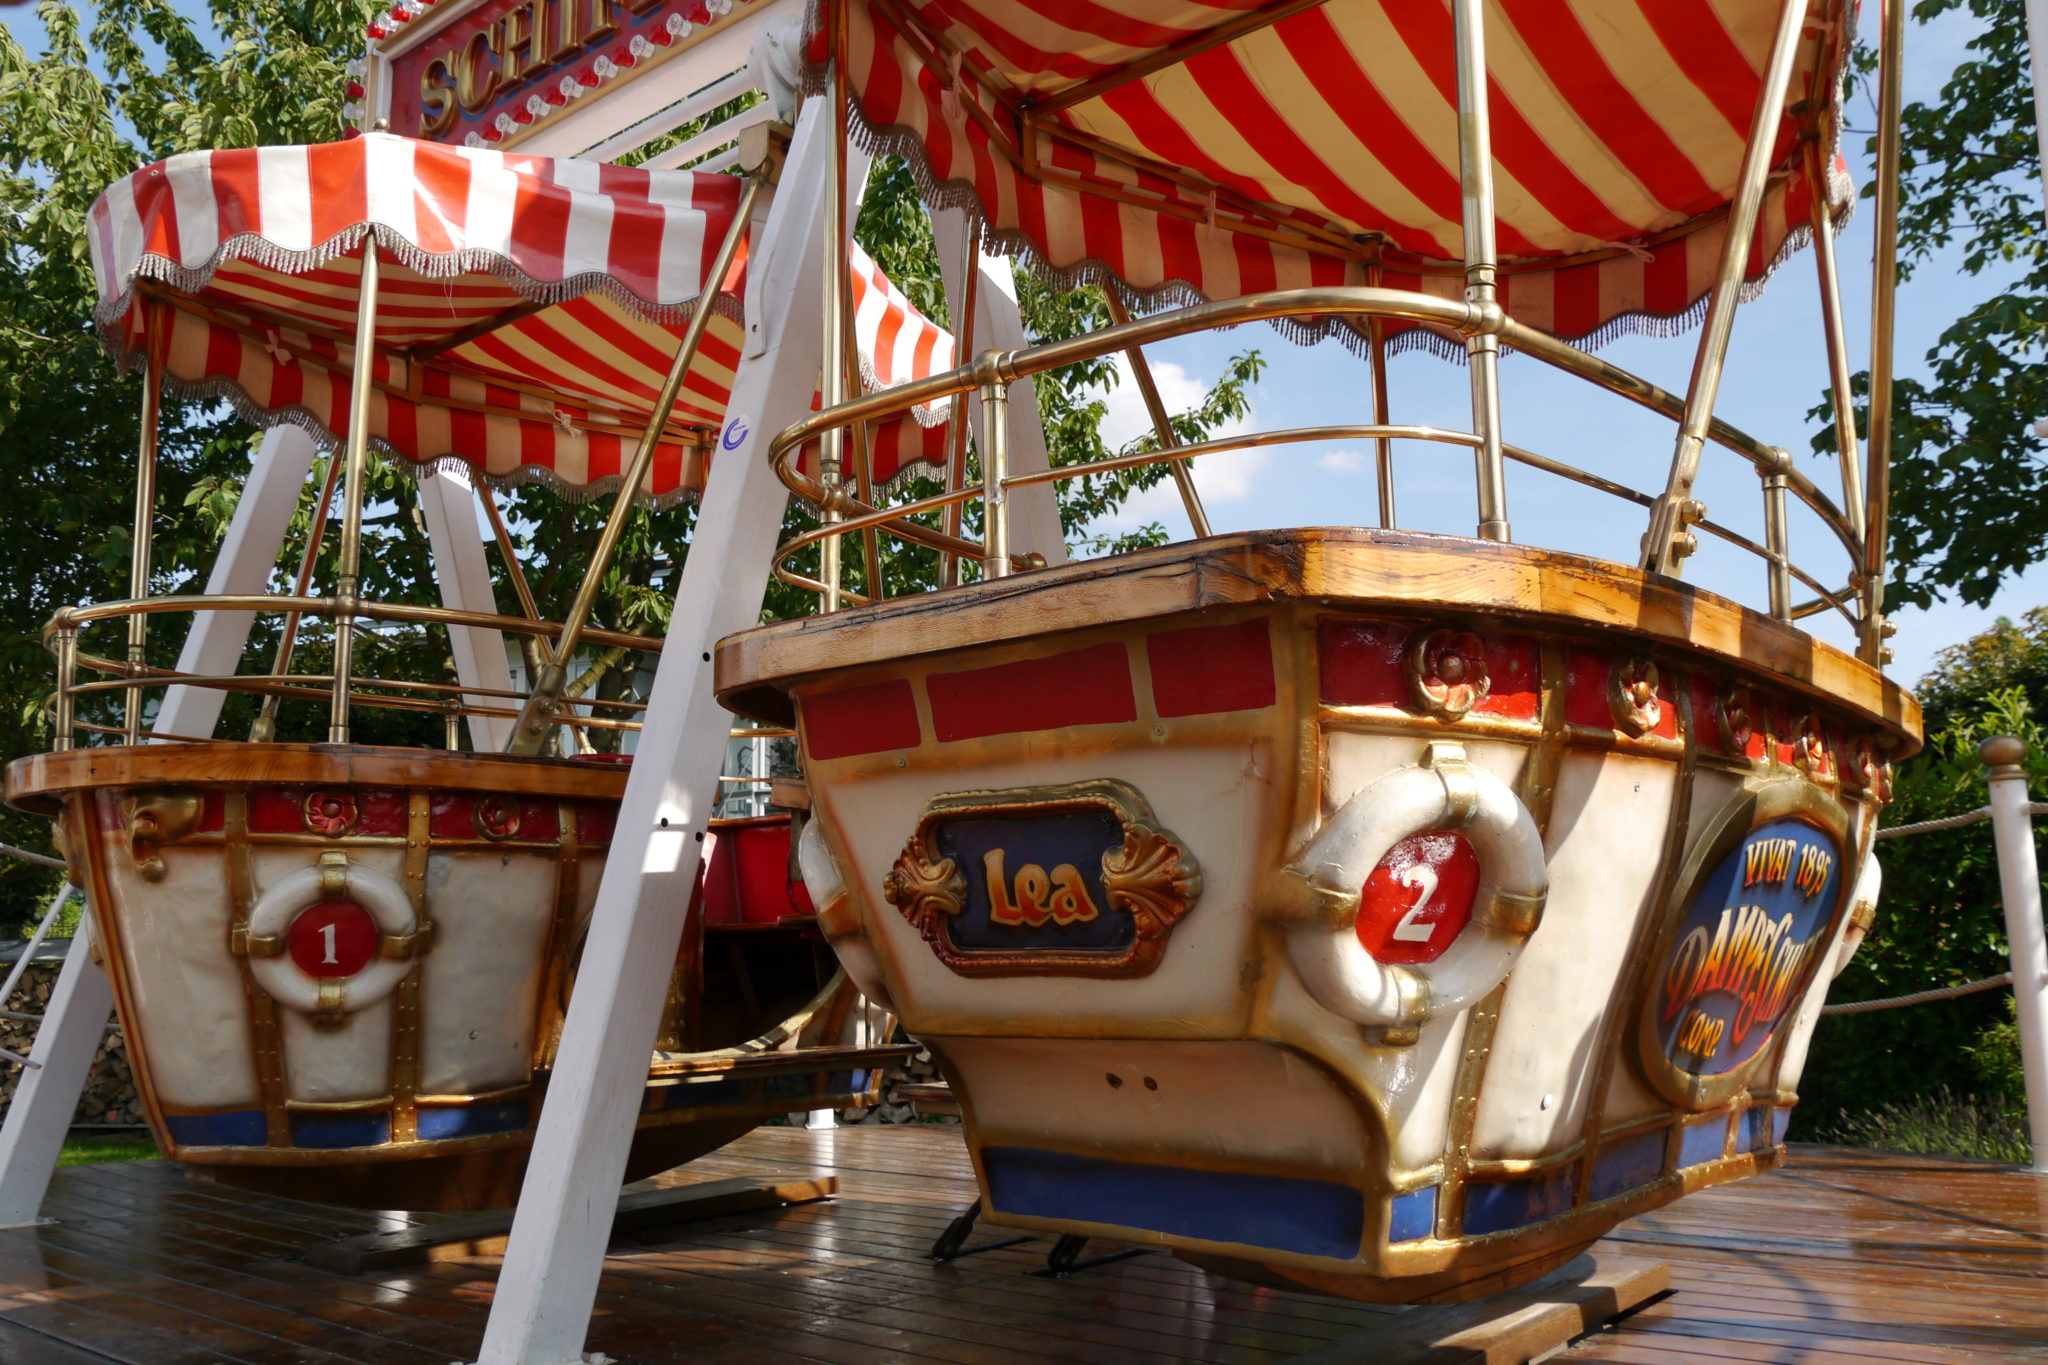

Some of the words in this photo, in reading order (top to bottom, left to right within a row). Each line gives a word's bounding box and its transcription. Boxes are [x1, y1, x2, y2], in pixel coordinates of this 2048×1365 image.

[983, 849, 1099, 927] Lea
[1744, 838, 1797, 887] VIVAT
[1795, 843, 1832, 897] 1895
[1393, 863, 1438, 942] 2
[318, 923, 339, 964] 1
